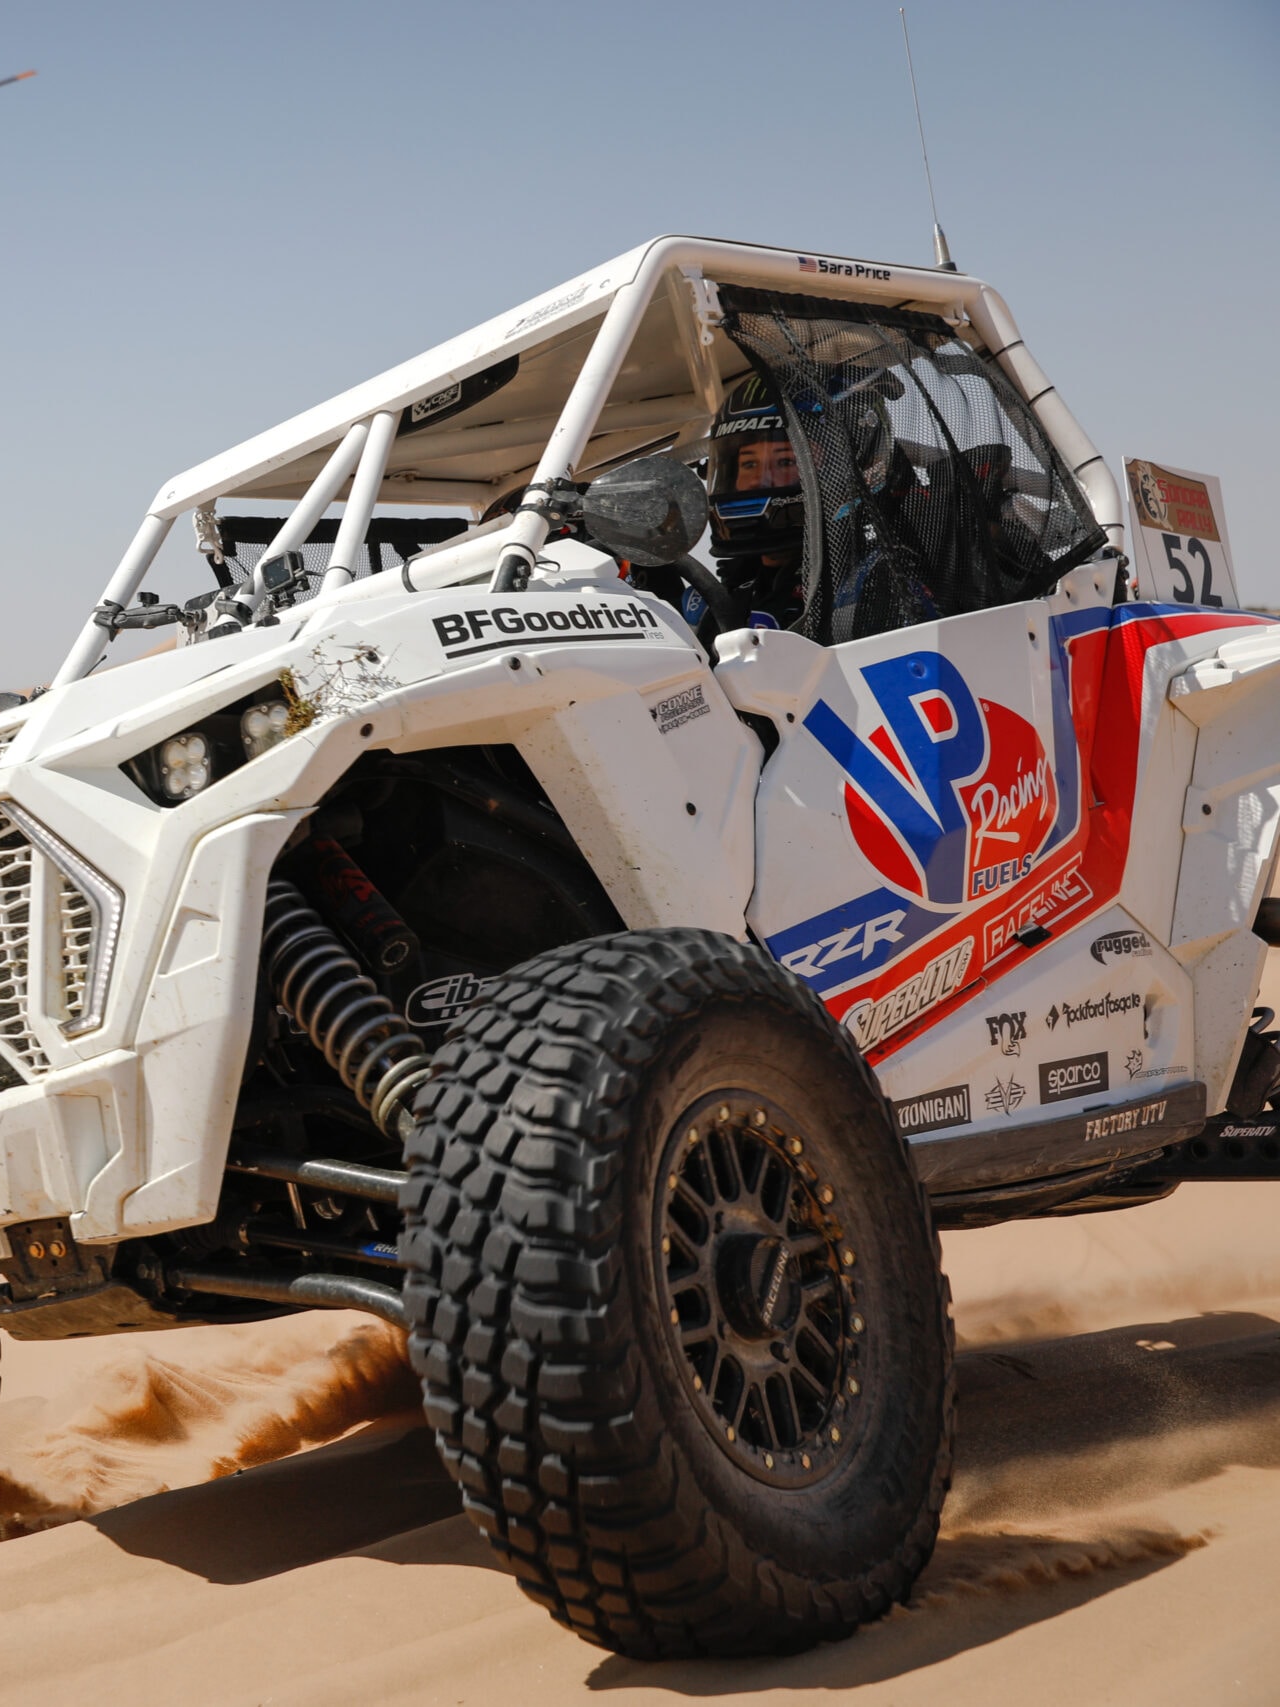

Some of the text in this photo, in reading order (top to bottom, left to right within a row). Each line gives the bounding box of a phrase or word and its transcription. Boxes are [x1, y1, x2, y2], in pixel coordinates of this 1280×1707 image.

[818, 259, 891, 281] Sara Price
[715, 415, 784, 438] IMPACT
[1161, 532, 1223, 607] 52
[432, 603, 658, 647] BFGoodrich
[644, 628, 665, 640] Tires
[658, 685, 702, 715] COYNE
[803, 651, 986, 904] VP
[971, 756, 1049, 867] Racing
[972, 853, 1034, 896] FUELS
[991, 868, 1084, 956] RACELINE
[780, 909, 908, 978] RZR
[985, 1011, 1027, 1053] FOX
[1048, 1061, 1101, 1094] sparco
[898, 1088, 968, 1129] OONIGAN]
[1084, 1101, 1168, 1142] FACTORY UTV
